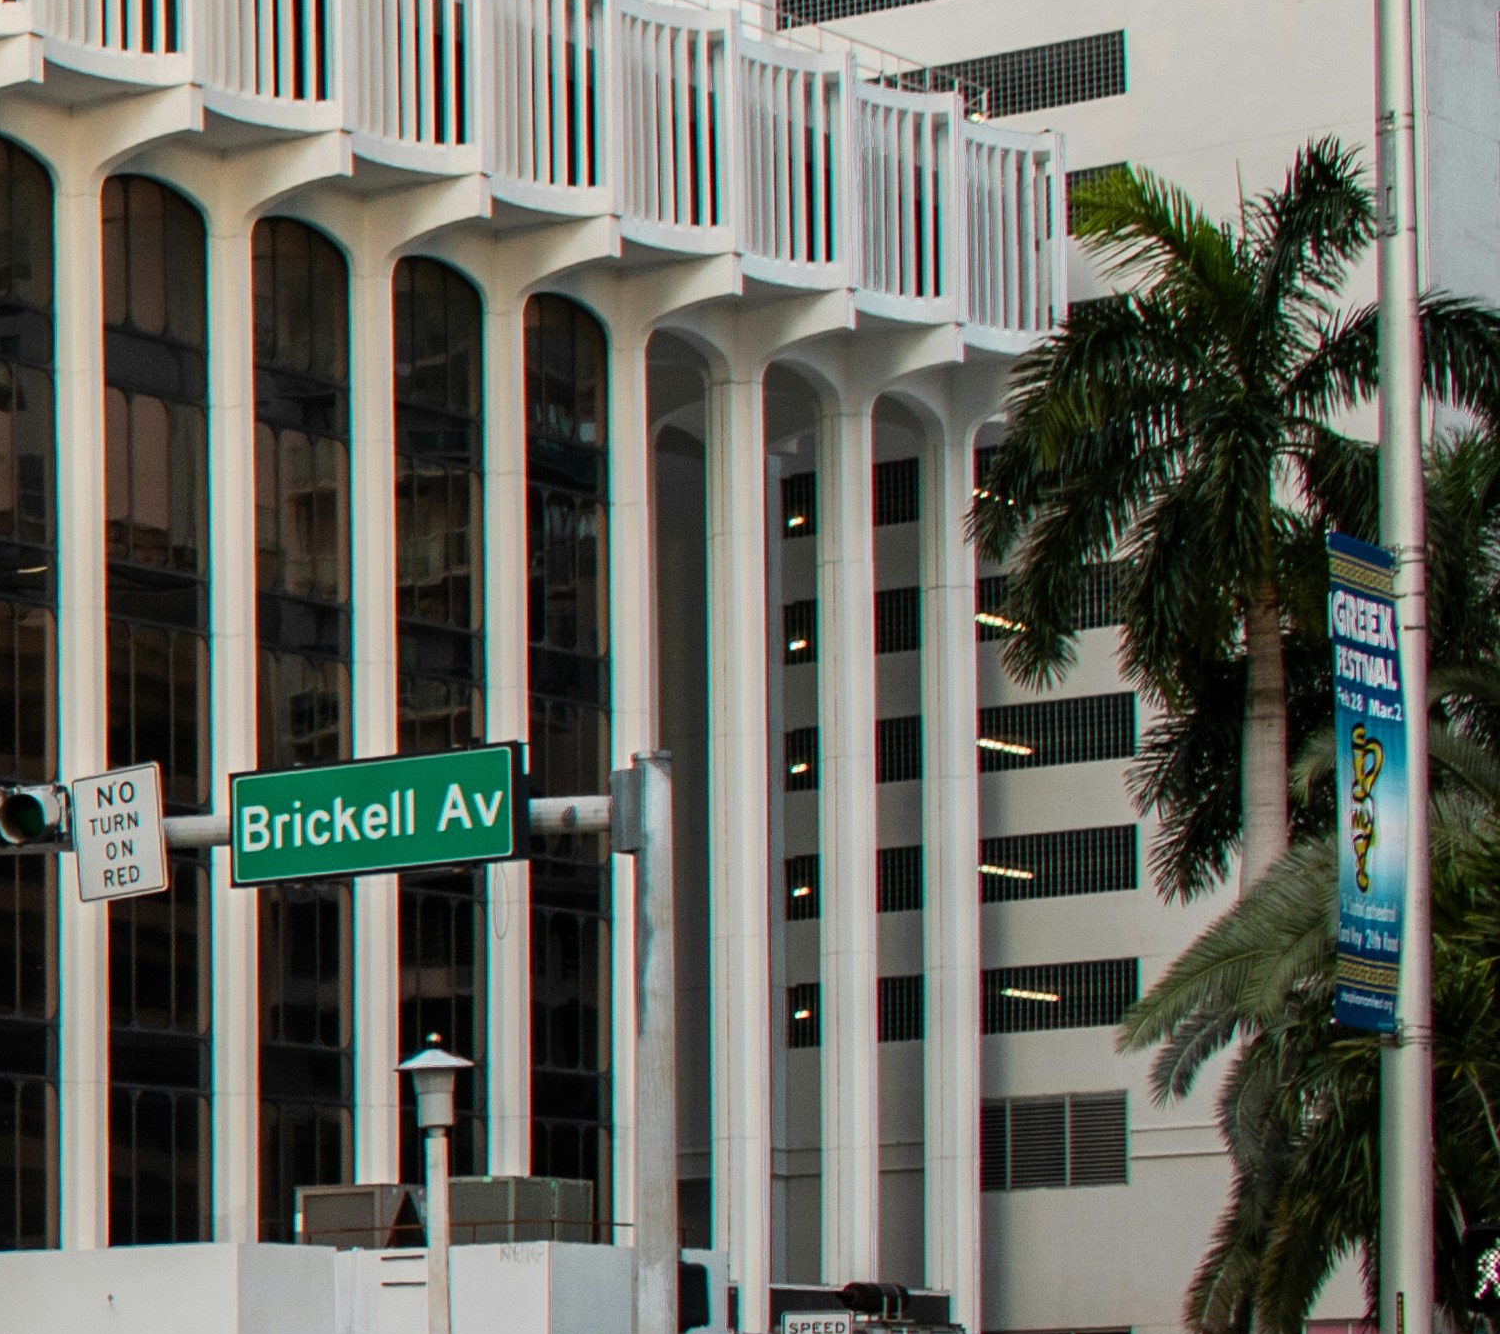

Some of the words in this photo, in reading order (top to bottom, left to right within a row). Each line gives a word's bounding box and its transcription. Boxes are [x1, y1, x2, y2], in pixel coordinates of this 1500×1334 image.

[1332, 590, 1397, 651] GREEK
[96, 781, 135, 808] NO
[88, 811, 140, 836] TURN
[241, 788, 415, 853] Brickell
[436, 783, 504, 833] Av
[106, 839, 134, 860] ON
[104, 865, 140, 888] RED
